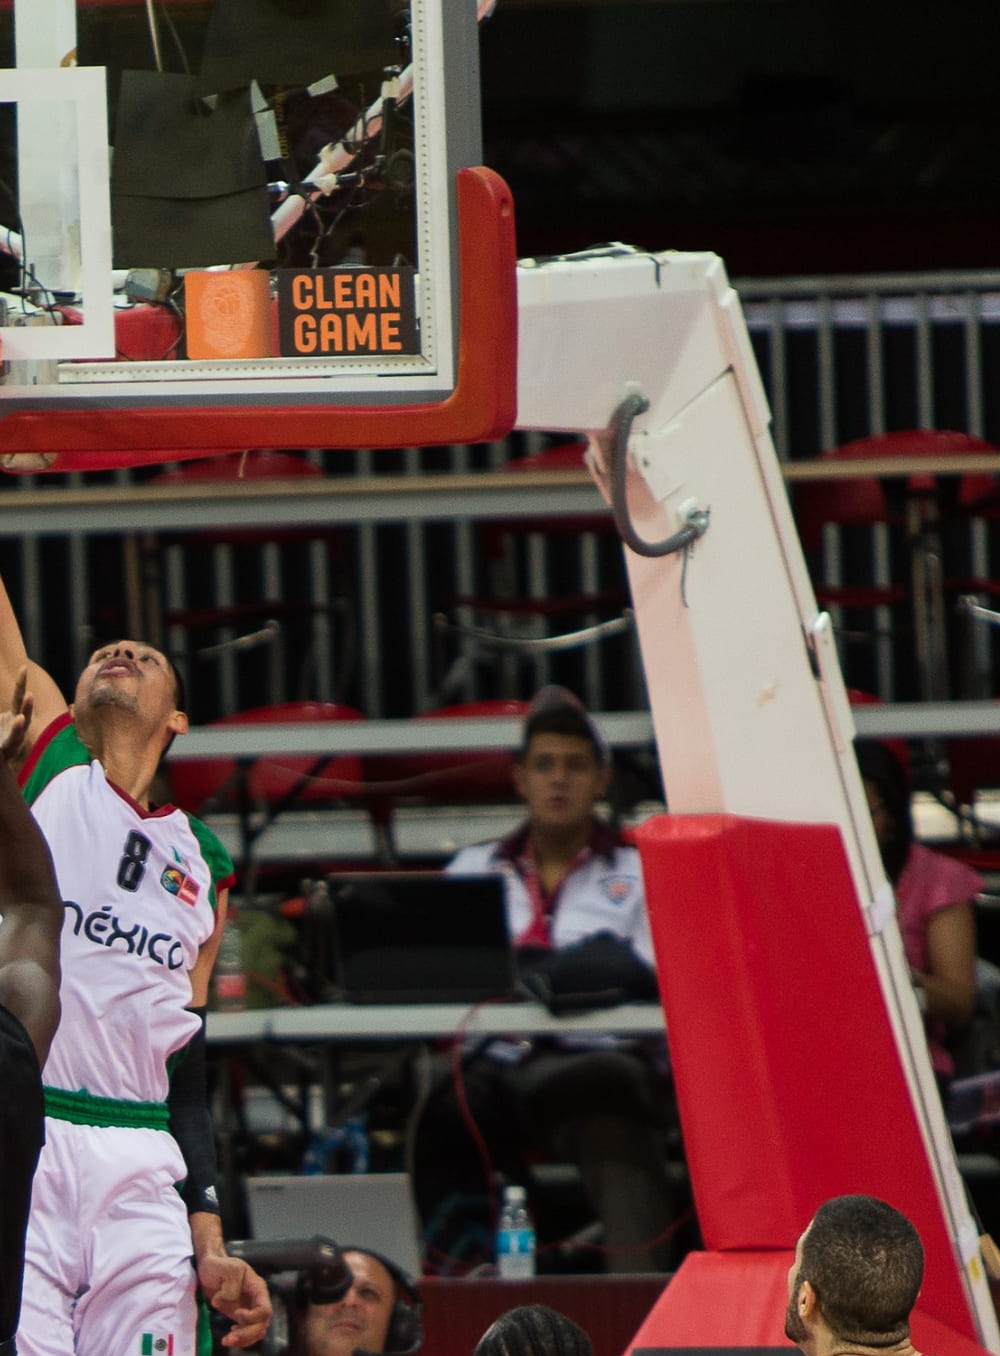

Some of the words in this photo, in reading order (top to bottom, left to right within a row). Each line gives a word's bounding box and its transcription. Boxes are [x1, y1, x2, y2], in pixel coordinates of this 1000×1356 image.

[292, 273, 401, 310] CLEAN
[294, 313, 402, 353] GAME
[116, 829, 152, 893] 8
